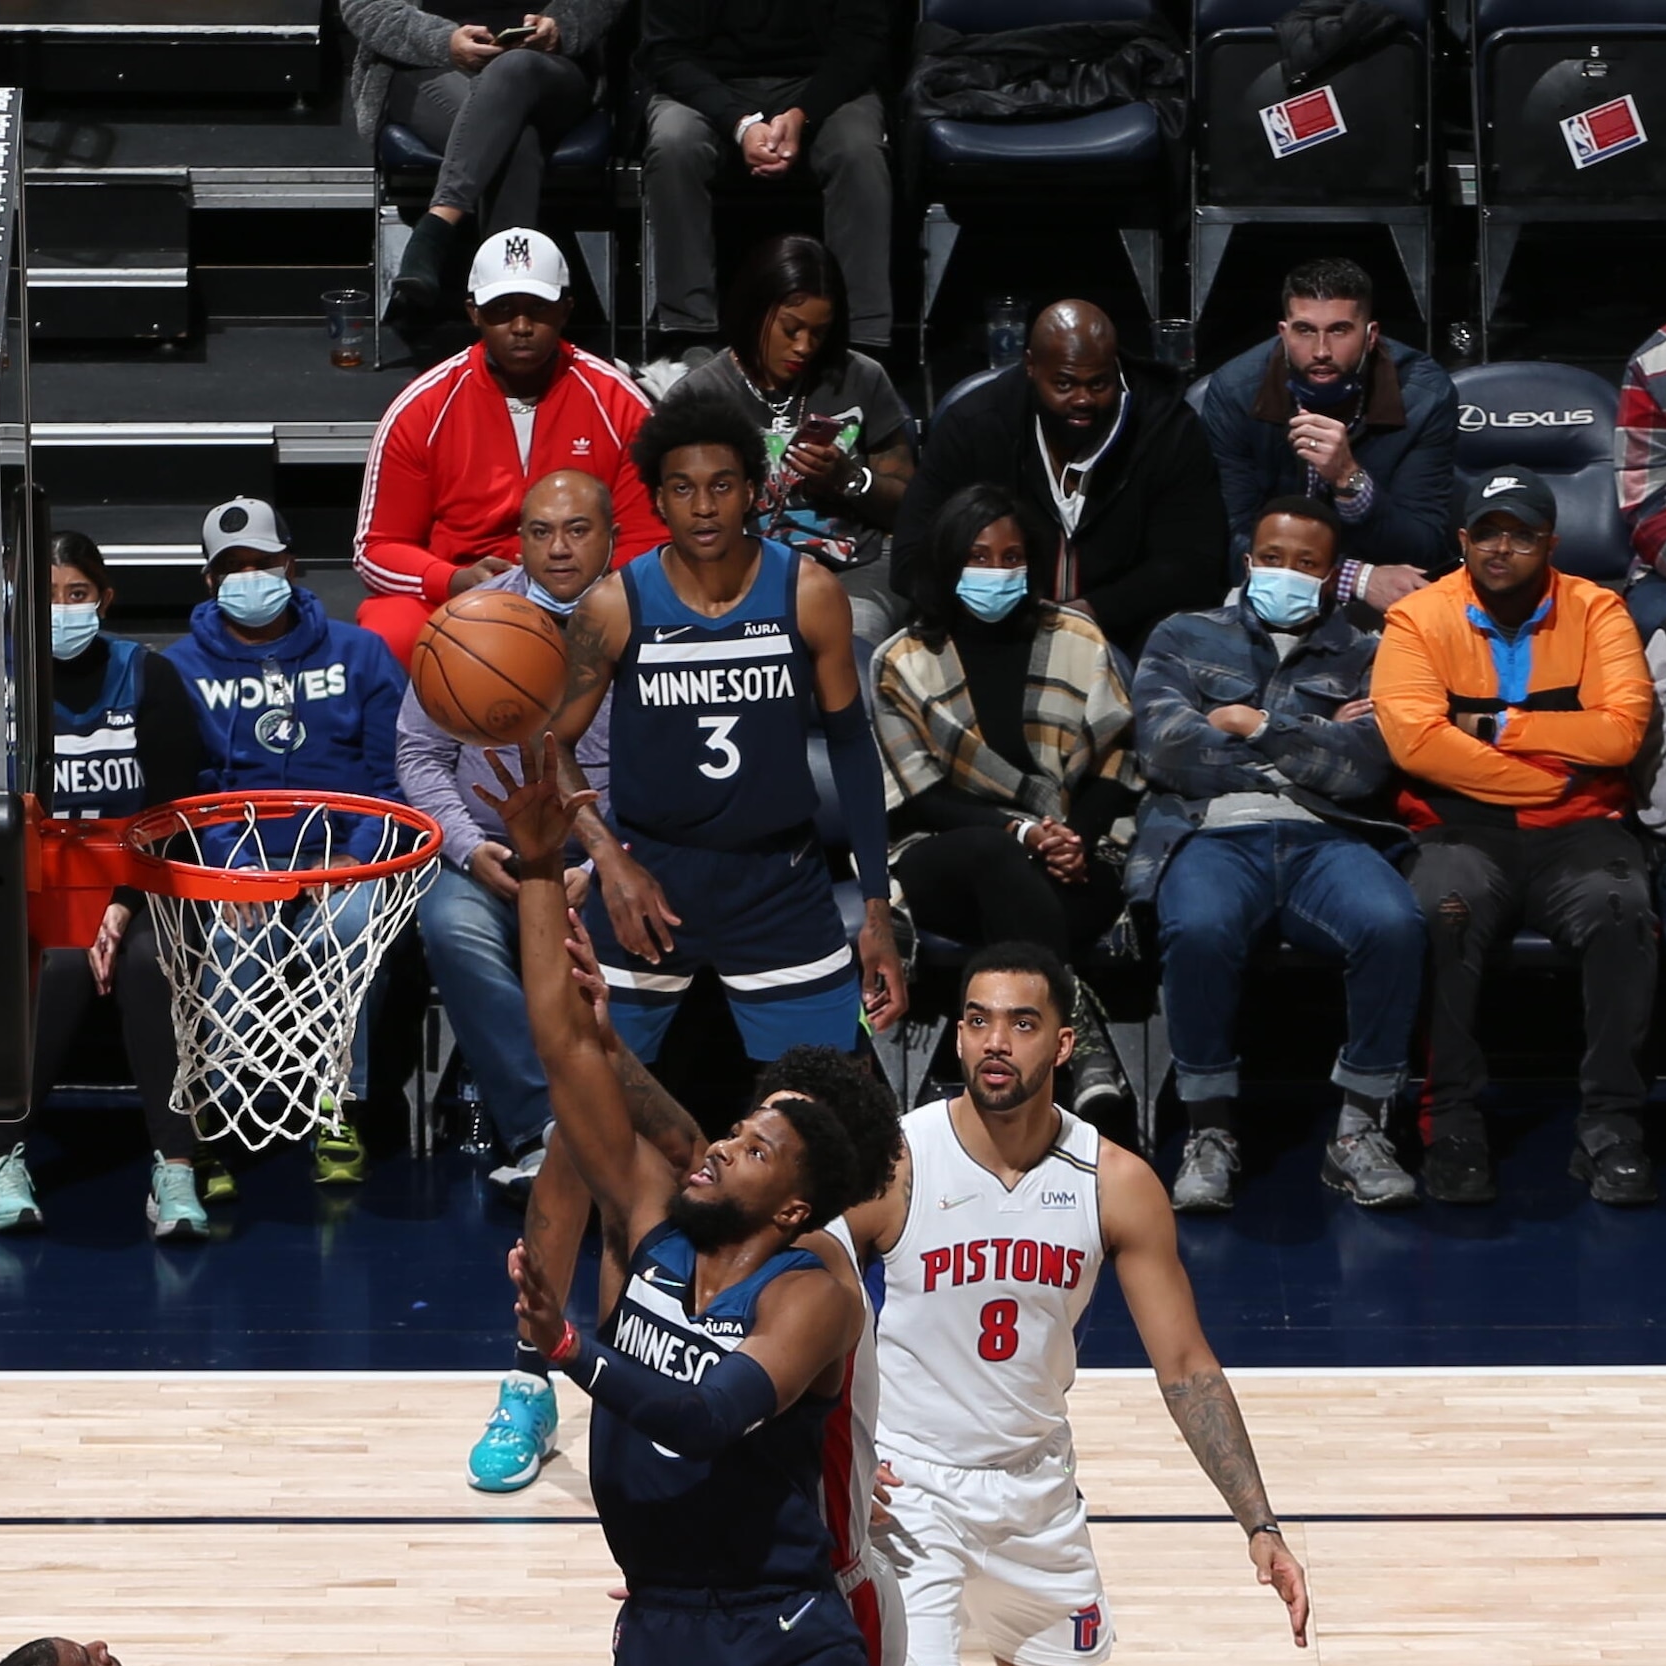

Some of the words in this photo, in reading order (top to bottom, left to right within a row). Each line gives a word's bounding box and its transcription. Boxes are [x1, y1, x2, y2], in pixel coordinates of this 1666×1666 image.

[1590, 45, 1600, 58] 5
[1489, 409, 1595, 428] LEXUS
[637, 664, 795, 706] MINNESOTA
[697, 715, 742, 780] 3
[1041, 1191, 1076, 1206] UWM
[920, 1238, 1086, 1293] PISTONS
[978, 1298, 1019, 1362] 8
